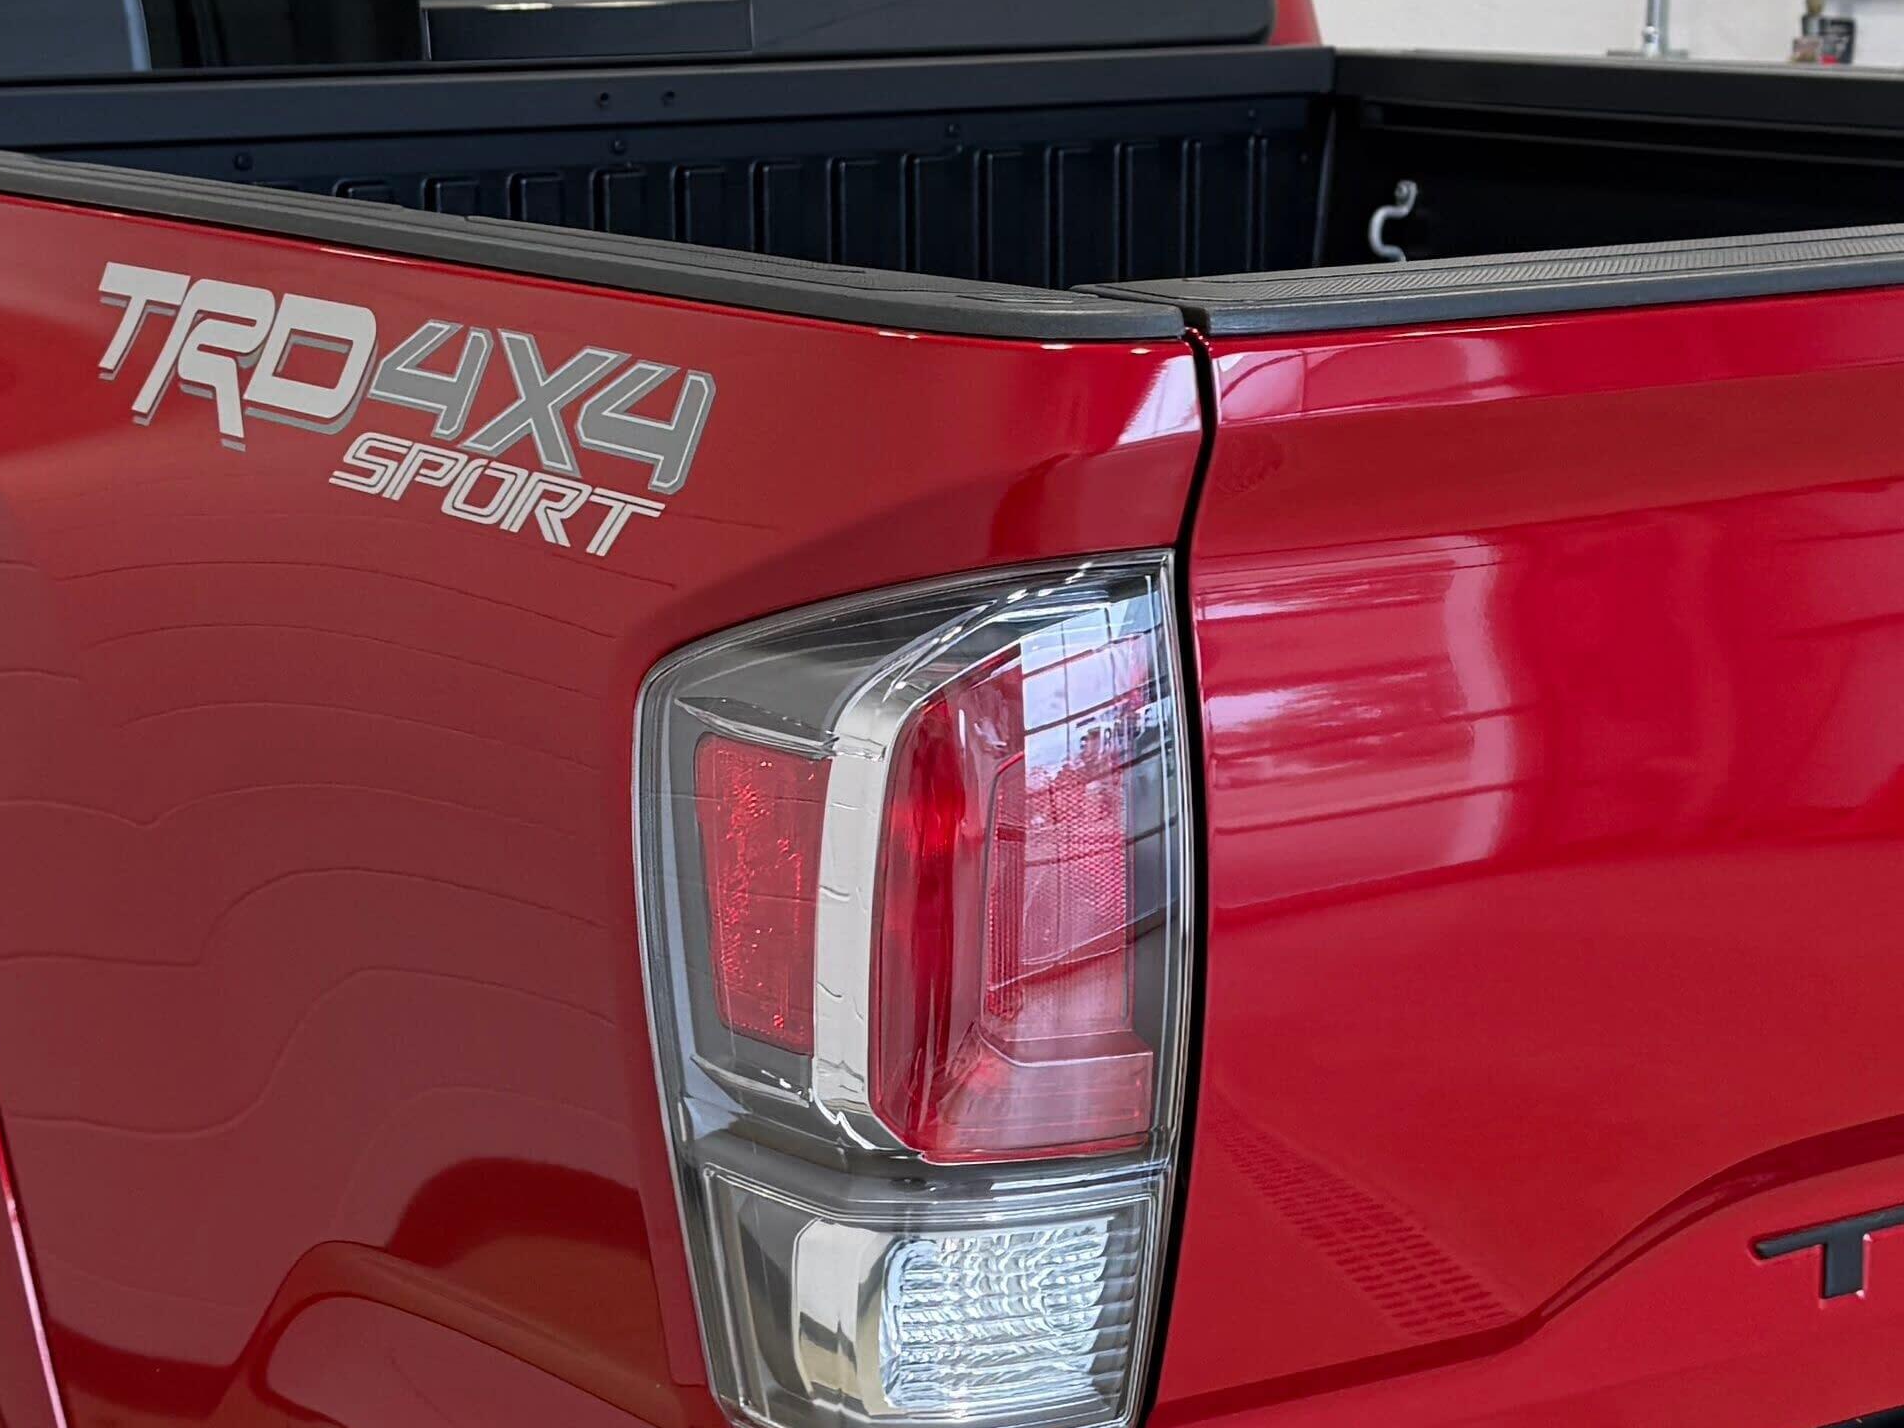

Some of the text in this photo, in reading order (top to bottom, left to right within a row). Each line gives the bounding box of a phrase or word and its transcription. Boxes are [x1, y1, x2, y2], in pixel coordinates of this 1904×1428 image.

[98, 261, 717, 496] TRD 4X4
[328, 431, 666, 557] SPORT
